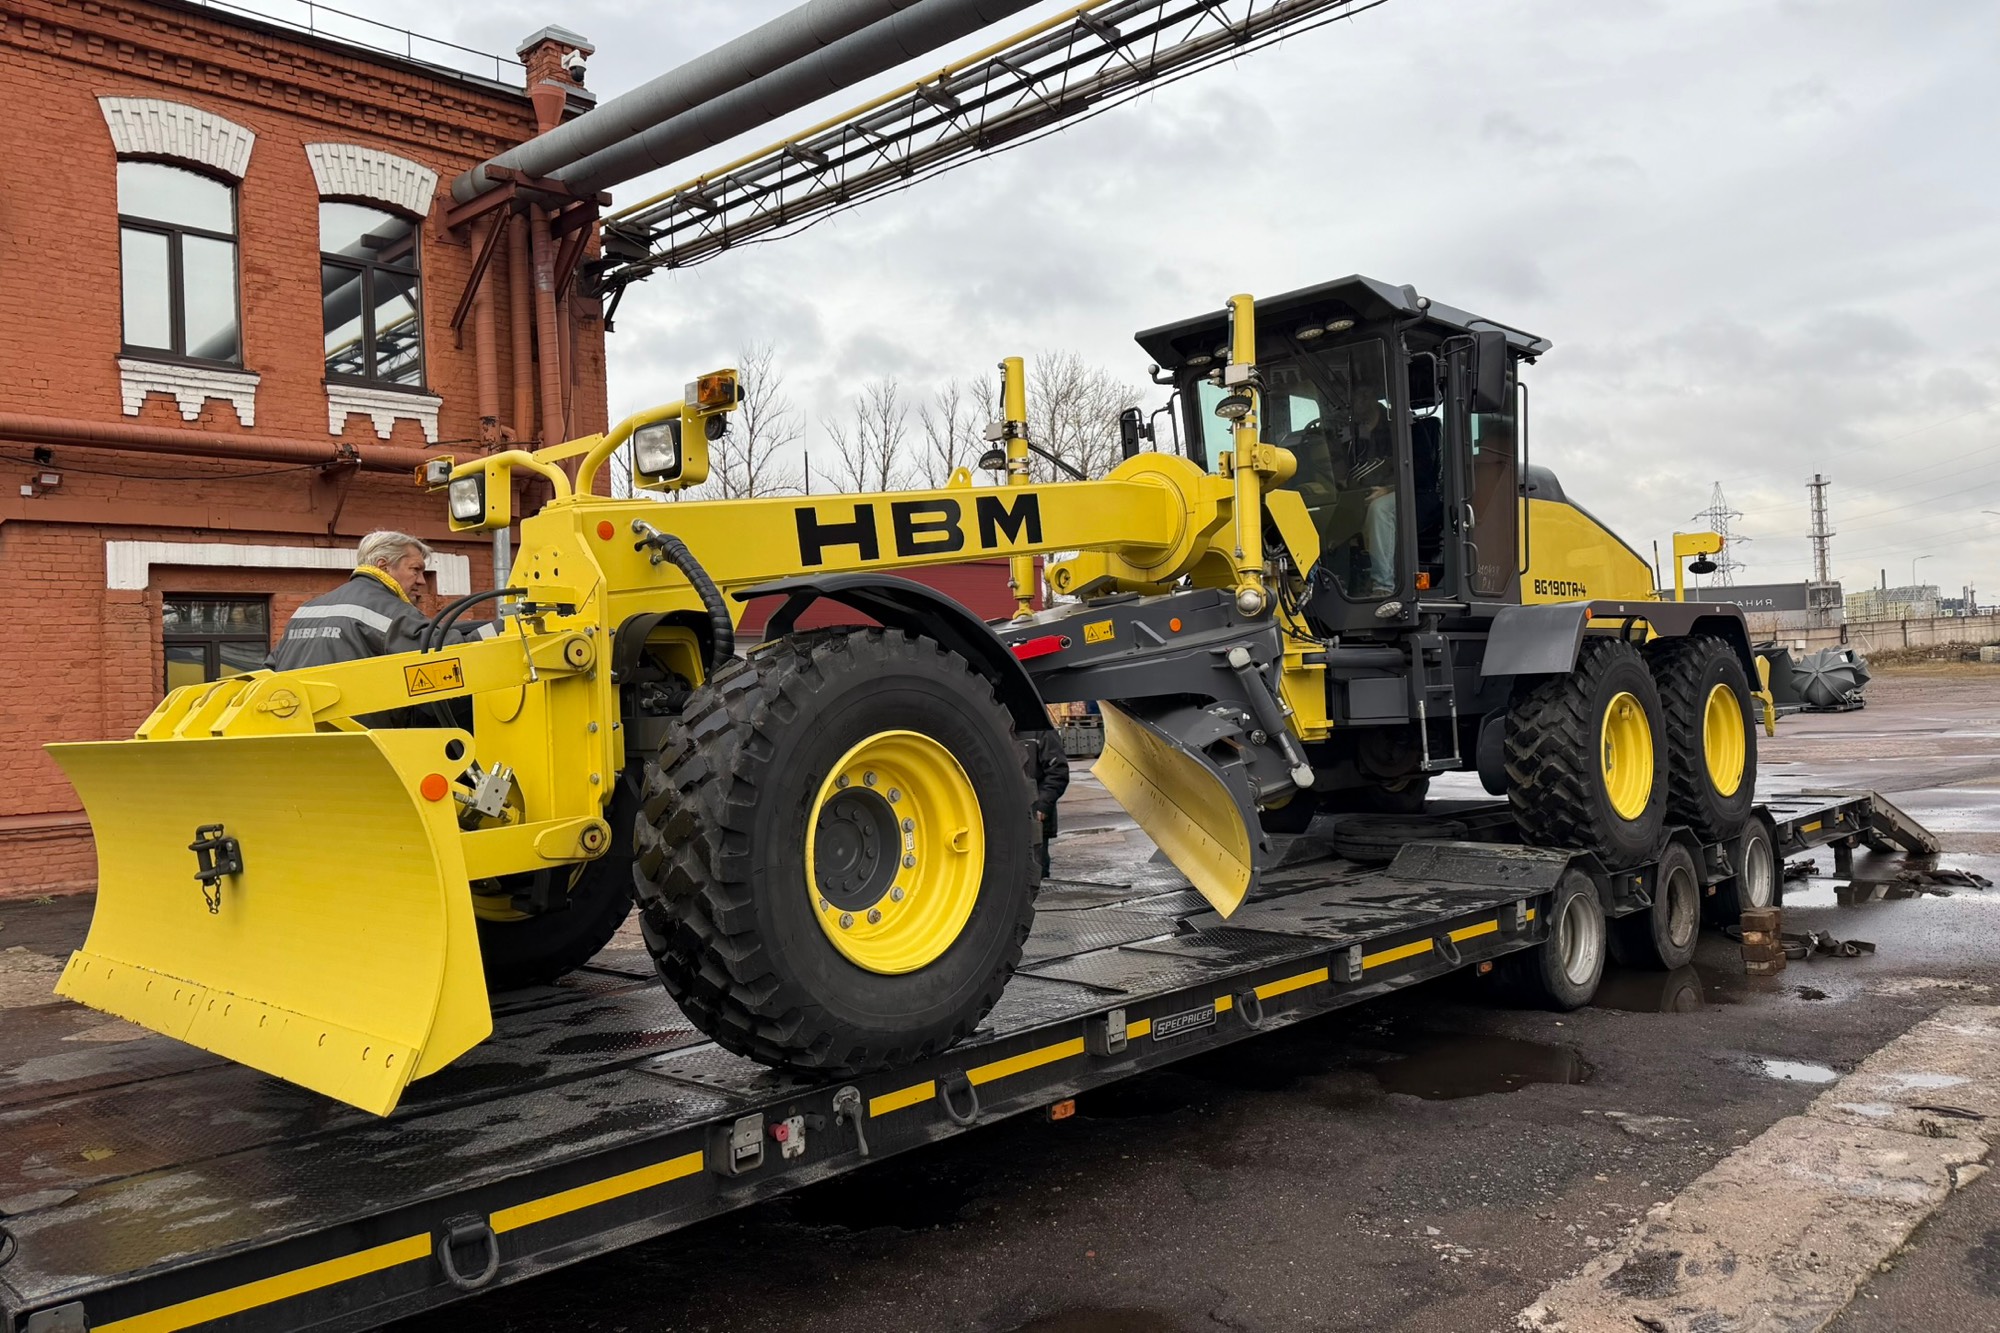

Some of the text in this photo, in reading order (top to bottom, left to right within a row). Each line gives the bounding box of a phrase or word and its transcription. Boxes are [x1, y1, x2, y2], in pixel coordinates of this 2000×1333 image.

[795, 493, 1043, 566] HBM
[1534, 579, 1586, 597] BG190TA-4
[1729, 598, 1774, 607] АНИЯ
